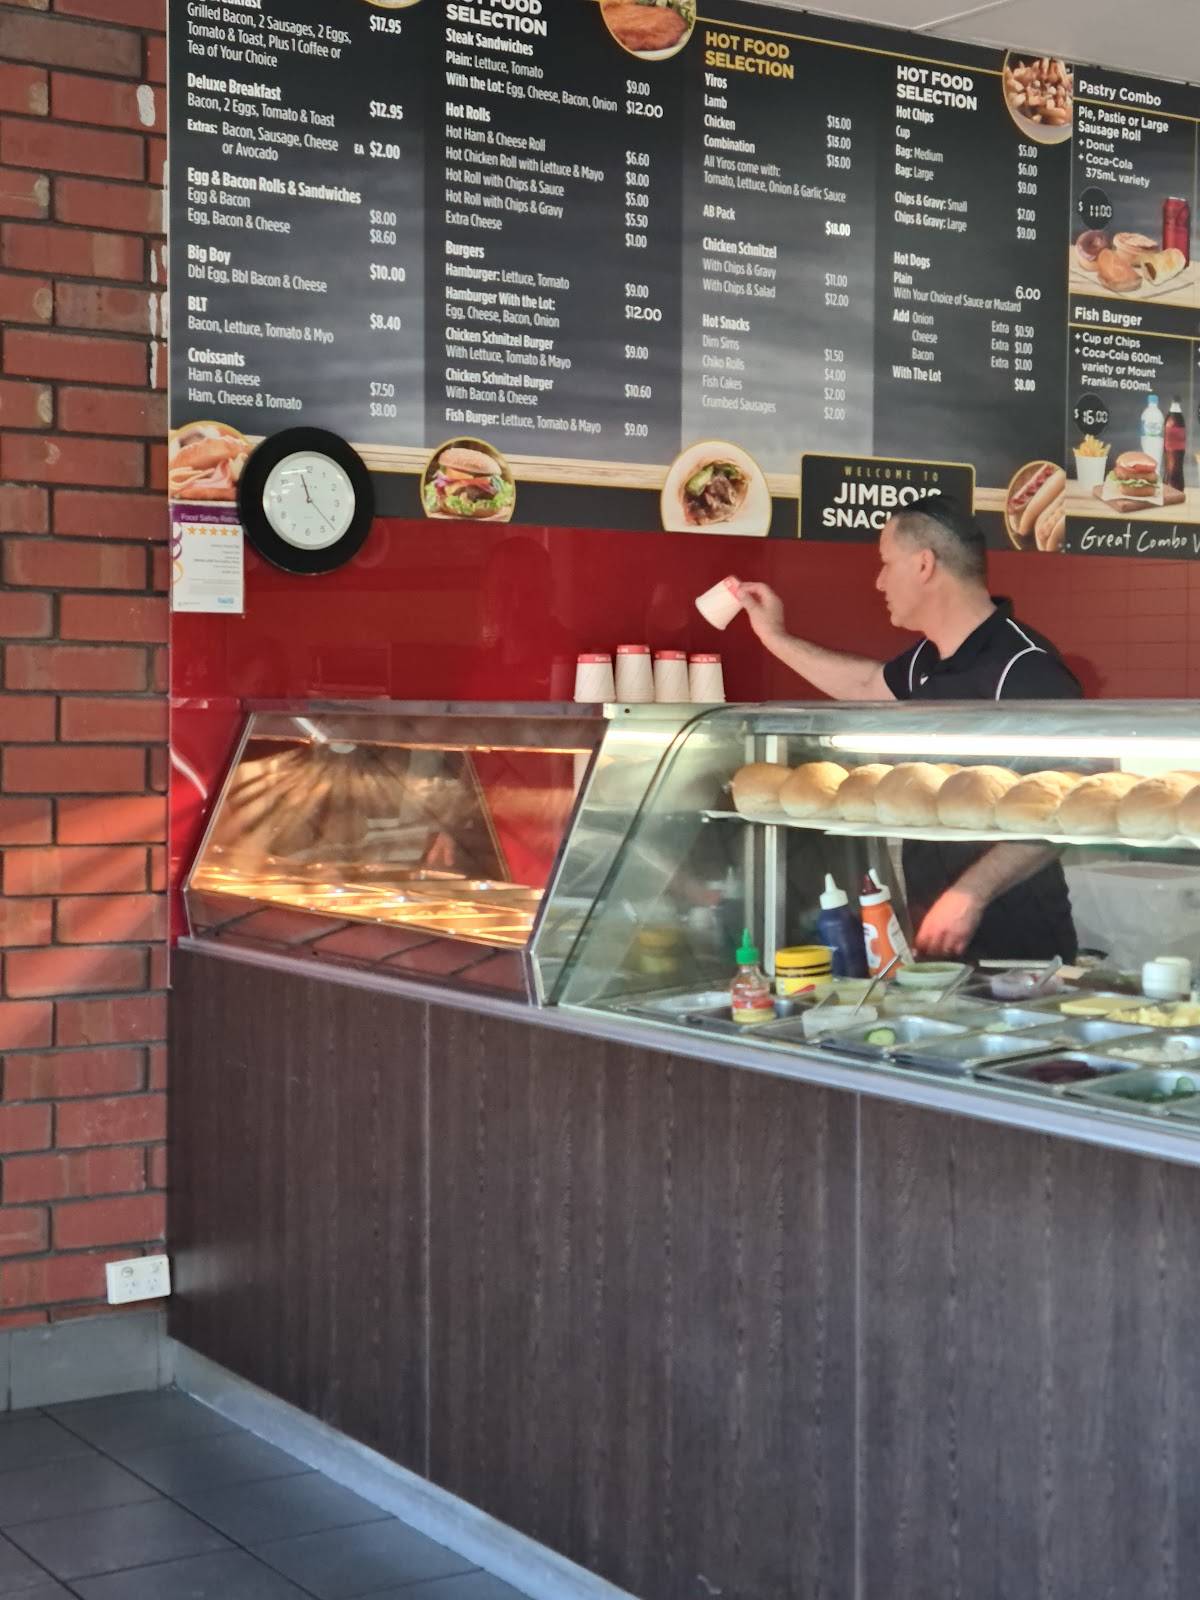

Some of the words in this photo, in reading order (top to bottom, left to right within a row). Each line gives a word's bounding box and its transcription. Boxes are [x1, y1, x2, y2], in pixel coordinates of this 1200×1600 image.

[490, 0, 542, 15] FOOD
[187, 2, 220, 20] Grilled
[223, 9, 256, 28] Bacon,
[259, 15, 265, 28] 2
[267, 16, 316, 37] Sausages,
[318, 24, 324, 36] 2
[326, 28, 351, 44] Eggs,
[369, 15, 401, 33] $17.95
[446, 4, 547, 36] SELECTION
[187, 21, 225, 39] Tomato
[228, 26, 236, 42] &
[238, 29, 267, 48] Toast,
[269, 35, 290, 50] Plus
[292, 38, 296, 51] 1
[298, 40, 328, 56] Coffee
[331, 48, 341, 59] or
[446, 28, 473, 45] Steak
[476, 34, 533, 56] Sandwiches
[706, 31, 740, 50] HOT
[744, 38, 789, 59] FOOD
[187, 40, 204, 54] Tea
[207, 43, 218, 56] of
[220, 45, 243, 61] Your
[245, 49, 277, 67] Choice
[446, 51, 472, 66] Plain:
[474, 55, 509, 74] Lettuce,
[511, 61, 543, 79] Tomato
[705, 50, 794, 79] SELECTION
[187, 73, 226, 93] Deluxe
[229, 79, 281, 100] Breakfast
[705, 72, 727, 89] Yiros
[897, 65, 929, 84] HOT
[931, 71, 973, 92] FOOD
[446, 72, 468, 88] With
[470, 77, 485, 90] the
[487, 80, 504, 93] Lot:
[507, 82, 525, 99] Egg,
[528, 86, 560, 104] Cheese,
[562, 92, 591, 109] Bacon,
[592, 96, 617, 112] Onion
[626, 80, 650, 96] $9.00
[1080, 80, 1116, 100] Pastry
[1120, 88, 1161, 106] Combo
[704, 94, 727, 109] Lamb
[896, 84, 977, 111] SELECTION
[188, 93, 221, 112] Bacon,
[224, 98, 230, 110] 2
[232, 100, 259, 118] Eggs,
[262, 103, 298, 122] Tomato
[300, 110, 308, 123] &
[310, 111, 334, 127] Toast
[369, 101, 403, 120] $12.95
[446, 102, 464, 118] Hot
[467, 105, 490, 122] Rolls
[626, 101, 663, 118] $12.00
[896, 105, 911, 119] Hot
[912, 107, 934, 124] Chips
[704, 114, 735, 131] Chicken
[827, 115, 851, 130] $15.00
[1079, 106, 1096, 121] Pie,
[1098, 109, 1126, 124] Pastie
[1128, 117, 1139, 126] or
[1141, 117, 1169, 133] Large
[446, 124, 461, 139] Hot
[464, 128, 485, 142] Ham
[487, 132, 494, 144] &
[496, 134, 527, 149] Cheese
[529, 137, 545, 151] Roll
[896, 125, 910, 139] Cup
[1079, 121, 1119, 139] Sausage
[1122, 128, 1141, 141] Roll
[704, 134, 755, 153] Combination
[827, 135, 851, 150] $15.00
[1086, 139, 1114, 152] Donut
[626, 151, 650, 166] $6.60
[827, 154, 851, 169] $15.00
[1086, 153, 1133, 170] Coca-Cola
[188, 167, 209, 185] Egg
[212, 171, 220, 185] &
[223, 172, 256, 190] Bacon
[259, 178, 285, 195] Rolls
[288, 182, 296, 195] &
[298, 182, 361, 204] Sandwiches
[626, 172, 649, 187] $8.00
[1086, 168, 1116, 181] 375mL
[1119, 174, 1150, 188] variety
[626, 193, 648, 208] $5.00
[369, 209, 396, 226] $8.00
[625, 213, 648, 228] $5.50
[703, 205, 715, 217] AB
[716, 206, 735, 220] Pack
[369, 229, 396, 245] $8.60
[188, 245, 207, 262] Big
[209, 247, 231, 265] Boy
[446, 240, 484, 258] Burgers
[703, 237, 736, 253] Chicken
[738, 242, 777, 258] Schnitzel
[894, 252, 909, 265] Hot
[910, 253, 930, 269] Dogs
[369, 264, 405, 282] $10.00
[446, 263, 500, 282] Hamburger:
[502, 270, 536, 287] Lettuce,
[538, 274, 569, 290] Tomato
[894, 272, 912, 285] Plain
[625, 283, 648, 298] $9.00
[1015, 285, 1041, 300] 6.00
[188, 296, 207, 312] BLT
[625, 305, 662, 321] $12.00
[369, 313, 401, 331] $8.40
[703, 314, 718, 328] Hot
[720, 316, 750, 331] Snacks
[893, 309, 910, 322] Add
[1075, 306, 1099, 321] Fish
[1102, 310, 1142, 327] Burger
[188, 316, 222, 333] Bacon,
[224, 320, 263, 337] Lettuce,
[266, 323, 302, 340] Tomato
[304, 328, 311, 341] &
[314, 328, 334, 344] Myo
[1082, 332, 1101, 344] Cup
[1103, 335, 1113, 344] of
[1115, 336, 1140, 348] Chips
[188, 347, 245, 367] Croissants
[1082, 347, 1129, 361] Coca-Cola
[1131, 352, 1163, 365] 600mL
[893, 365, 912, 379] With
[913, 367, 928, 381] The
[929, 368, 941, 382] Lot
[1082, 363, 1114, 375] variety
[1128, 366, 1156, 378] Mount
[1082, 375, 1118, 388] Franklin
[1120, 379, 1152, 392] 600mL
[369, 403, 396, 418] $8.00
[844, 466, 912, 480] WELCOME
[924, 471, 939, 482] TO
[1081, 523, 1131, 550] Great
[1137, 525, 1187, 552] Combo
